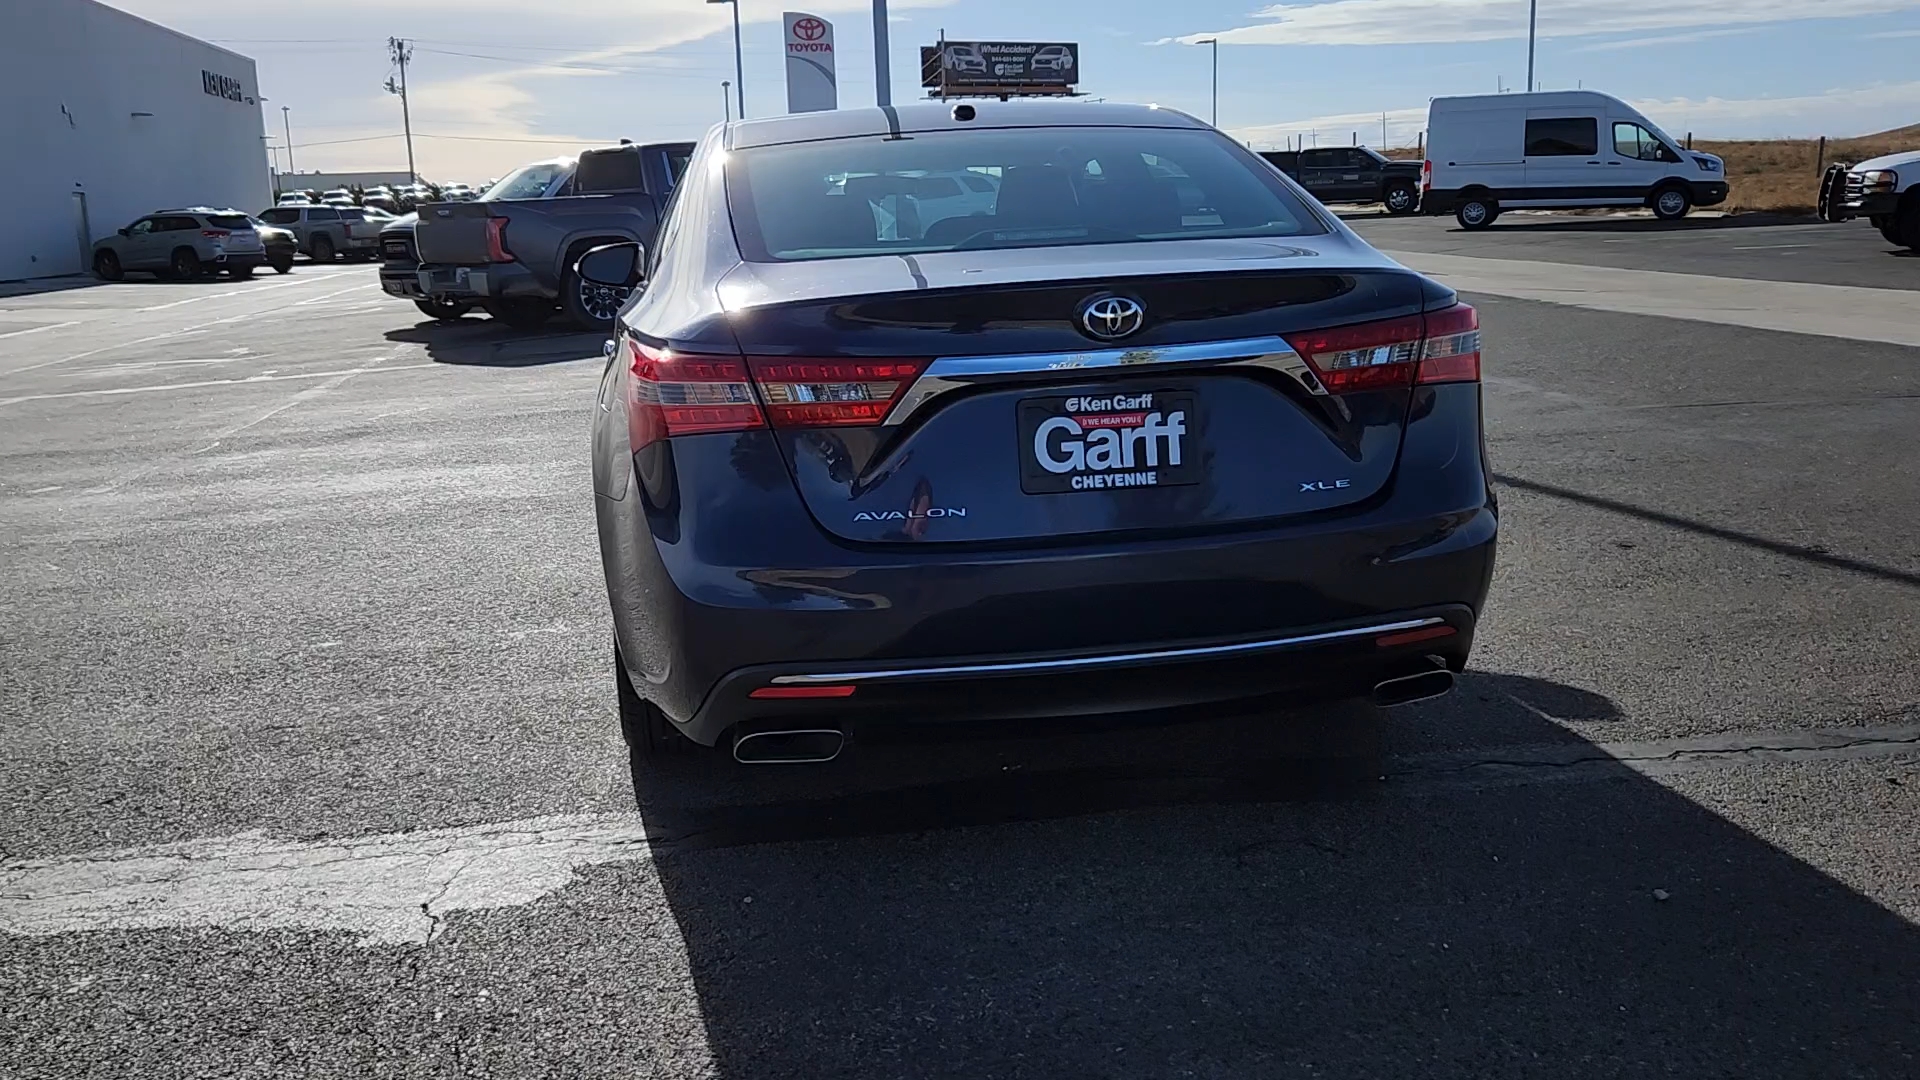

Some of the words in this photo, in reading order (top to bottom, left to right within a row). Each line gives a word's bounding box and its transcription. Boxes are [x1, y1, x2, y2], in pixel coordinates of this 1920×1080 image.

[787, 43, 832, 52] TOYOTA
[981, 44, 1000, 53] What
[1000, 44, 1036, 54] Accident?
[1080, 396, 1111, 412] Ken
[1113, 393, 1152, 410] Garff
[1088, 418, 1100, 426] WE
[1101, 417, 1121, 425] HEAR
[1121, 416, 1137, 424] YOU
[1034, 411, 1187, 474] Garff
[1071, 471, 1157, 490] CHEYENNE
[1299, 479, 1351, 492] XLE
[853, 508, 966, 521] AVALON
